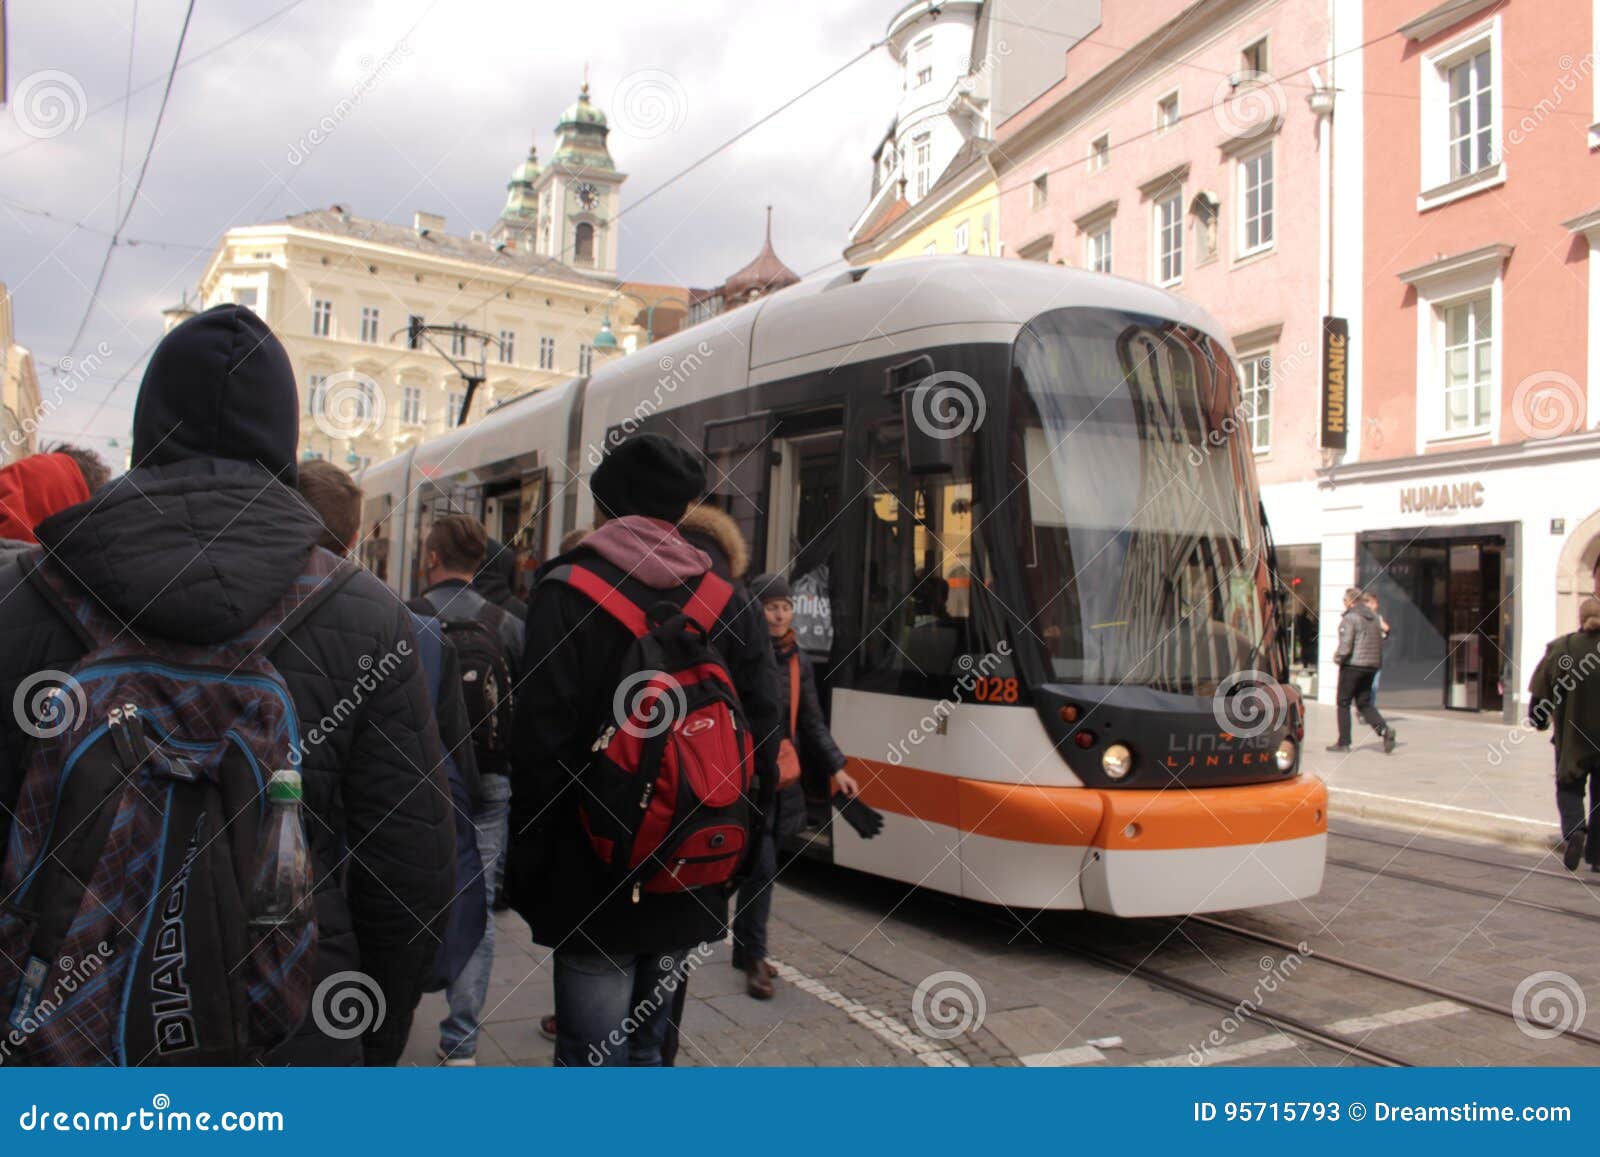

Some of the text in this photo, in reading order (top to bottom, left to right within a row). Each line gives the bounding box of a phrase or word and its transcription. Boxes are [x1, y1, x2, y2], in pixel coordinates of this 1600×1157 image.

[1328, 334, 1345, 432] HUMANIC
[1400, 481, 1484, 513] HUMANIC
[975, 676, 1019, 703] 028
[1167, 752, 1269, 767] LINIEN
